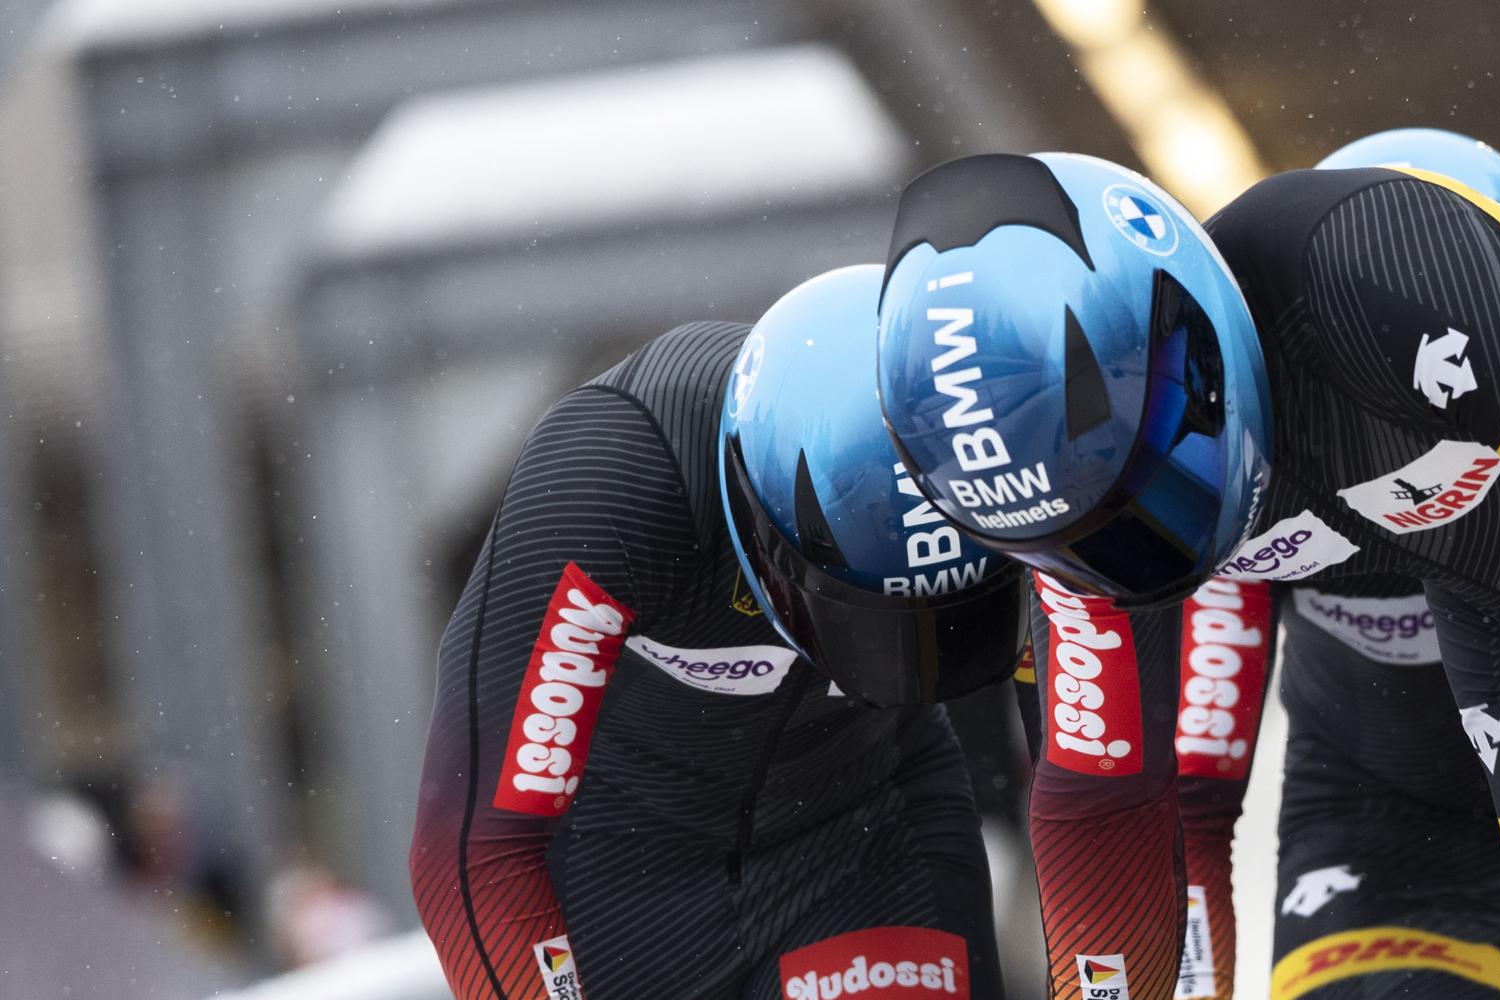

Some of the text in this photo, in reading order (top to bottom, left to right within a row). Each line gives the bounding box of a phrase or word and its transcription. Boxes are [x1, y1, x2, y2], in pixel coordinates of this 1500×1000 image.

[926, 308, 1011, 471] BMW
[948, 462, 1051, 508] BMW
[1383, 457, 1500, 529] NIGRIN
[893, 462, 961, 568] BM
[972, 498, 1070, 529] helmets
[884, 557, 987, 597] BMW
[642, 644, 774, 679] wheego
[513, 588, 624, 794] Nudossi
[1304, 938, 1460, 976] DHL
